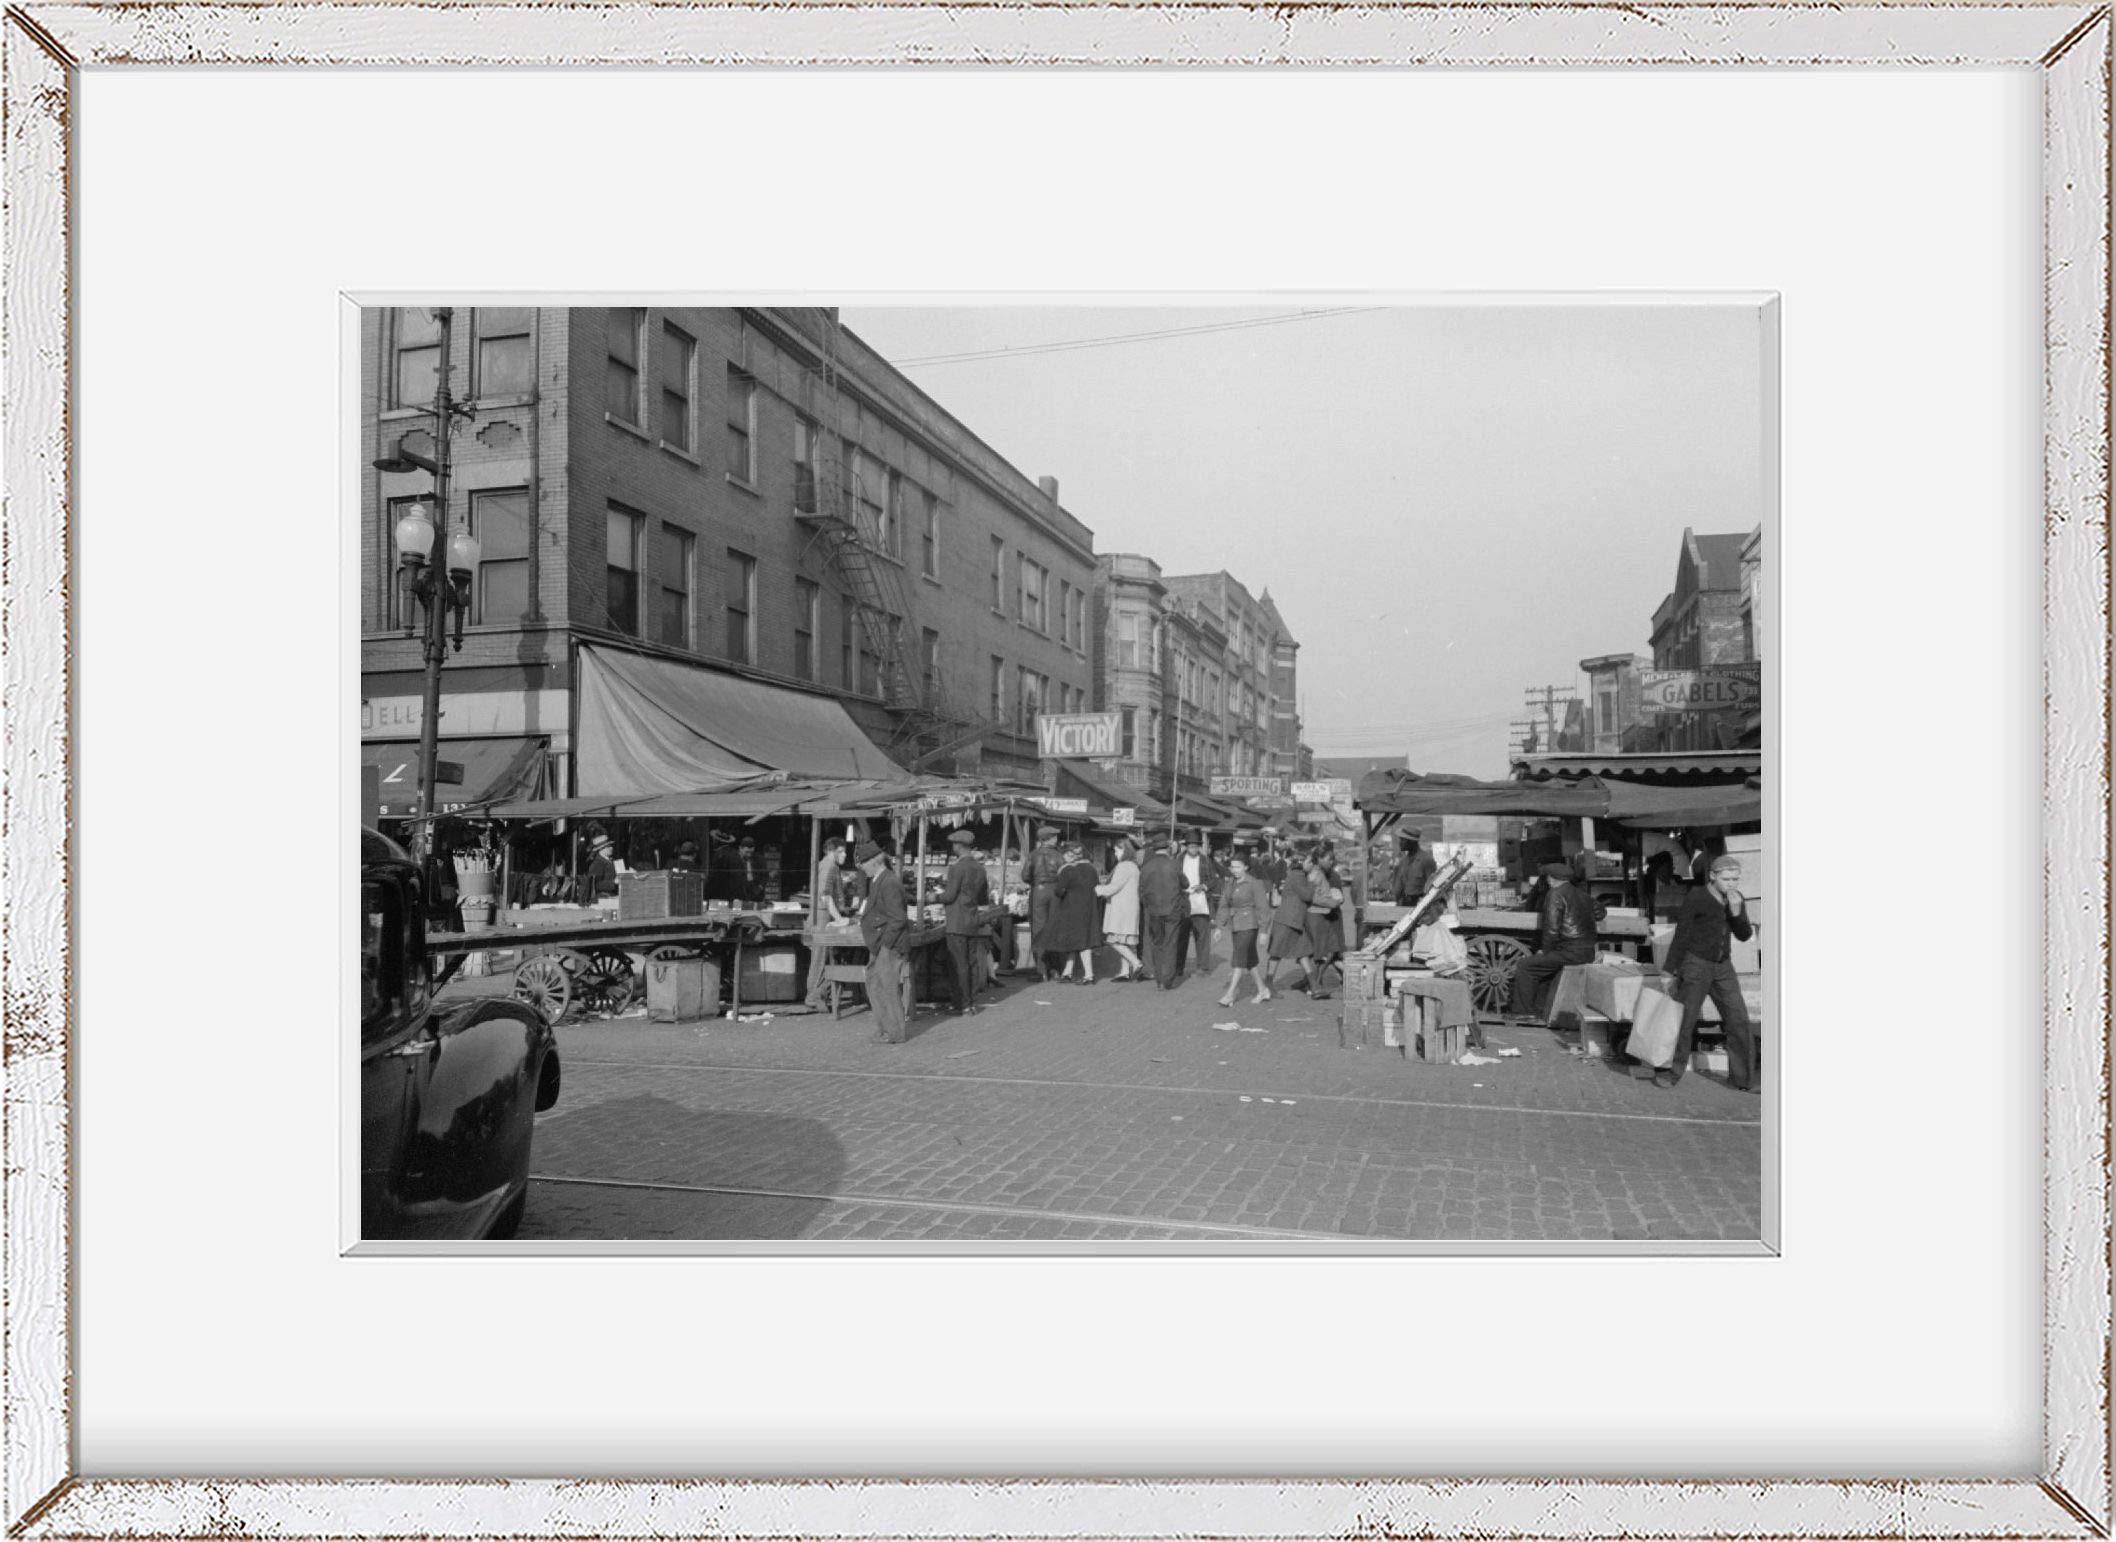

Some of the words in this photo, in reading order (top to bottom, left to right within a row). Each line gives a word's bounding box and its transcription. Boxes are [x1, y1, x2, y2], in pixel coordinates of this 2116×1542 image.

[1662, 681, 1739, 703] GABELS
[1041, 714, 1119, 755] VICTORY
[1222, 778, 1279, 794] SPORTING
